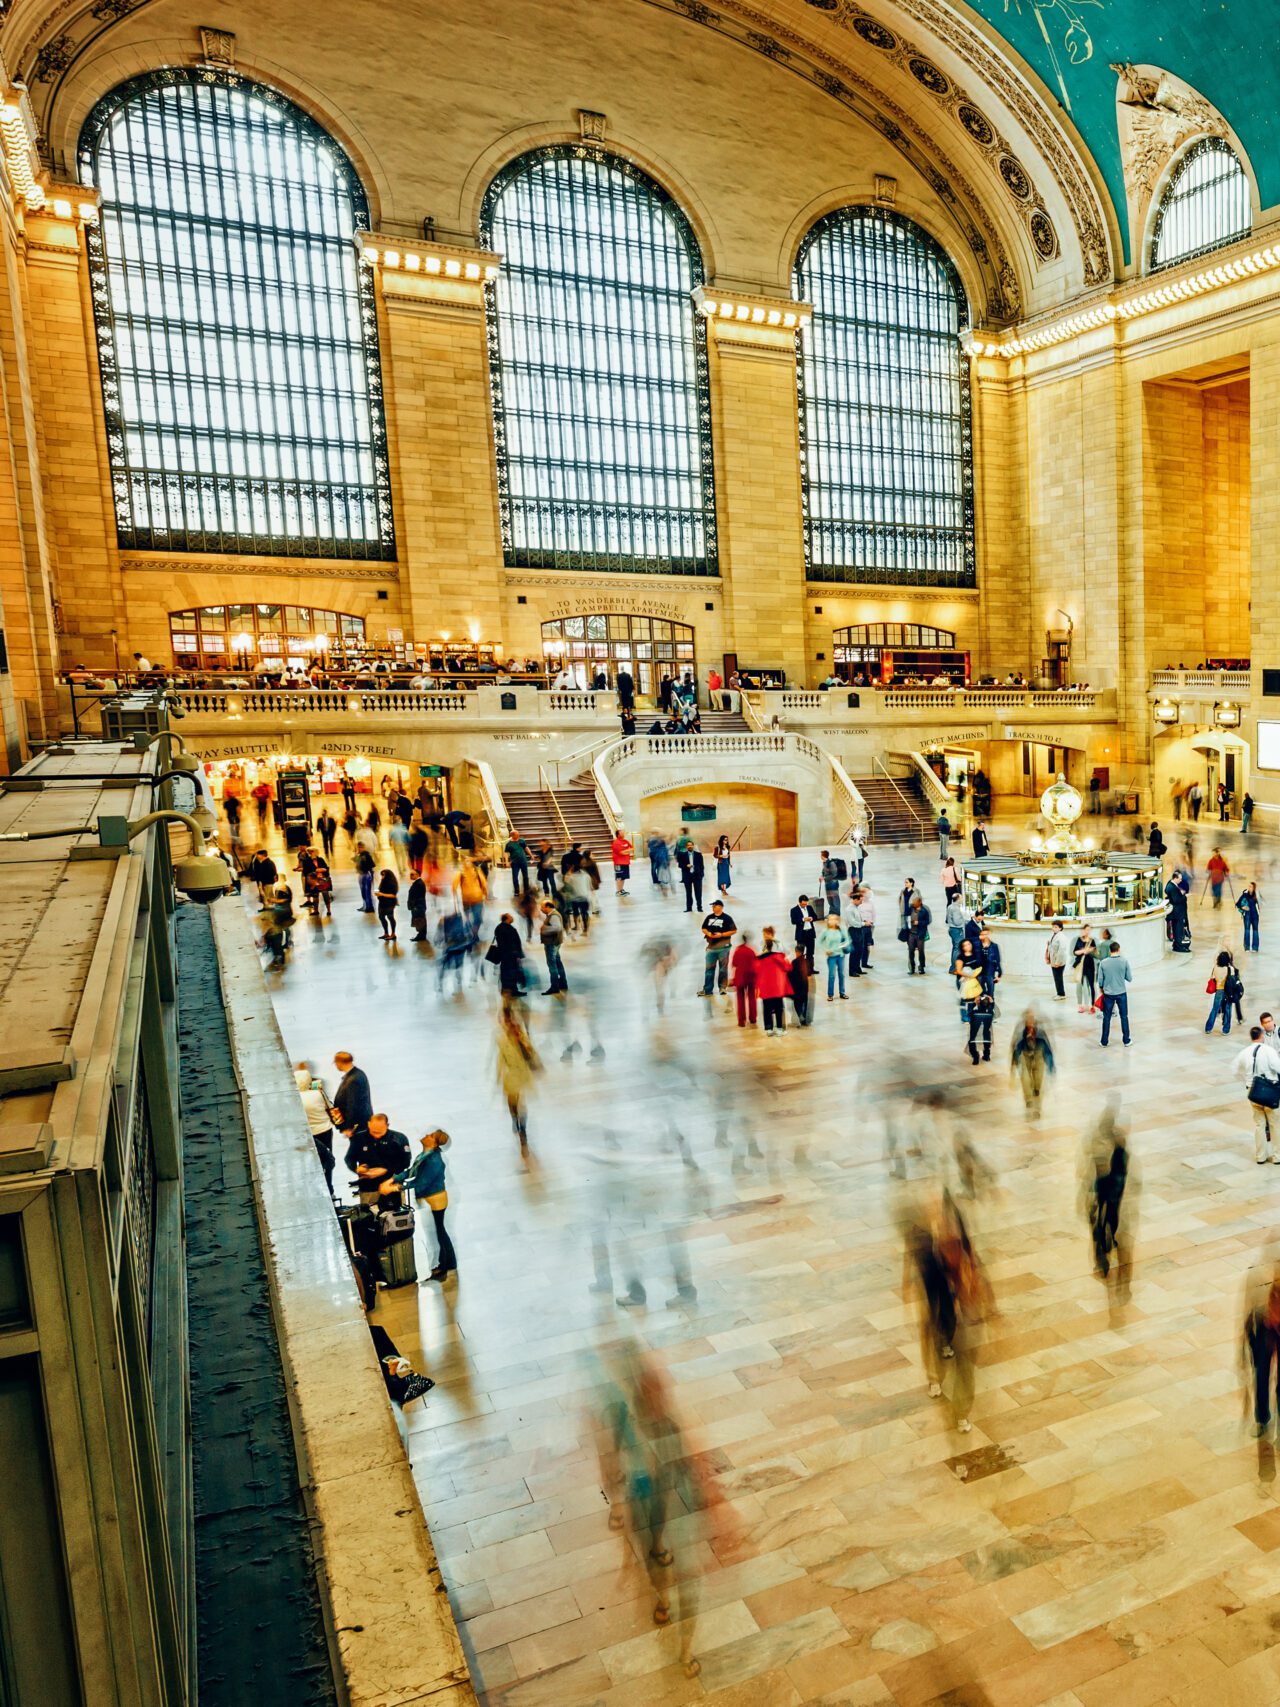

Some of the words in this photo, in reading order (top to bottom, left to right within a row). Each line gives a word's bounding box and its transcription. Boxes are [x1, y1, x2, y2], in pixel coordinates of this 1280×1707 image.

[576, 597, 636, 605] VANDERBILT
[642, 600, 679, 612] AVENUE
[550, 608, 570, 616] THE
[575, 604, 625, 612] CAMPBELL
[631, 606, 686, 620] APARTMENT
[920, 737, 944, 748] TICKET
[947, 732, 984, 742] MACHINES
[1008, 731, 1035, 739] TRACKS
[224, 743, 279, 756] SHUTTLE
[321, 743, 352, 752] 42ND
[354, 745, 396, 755] STREET
